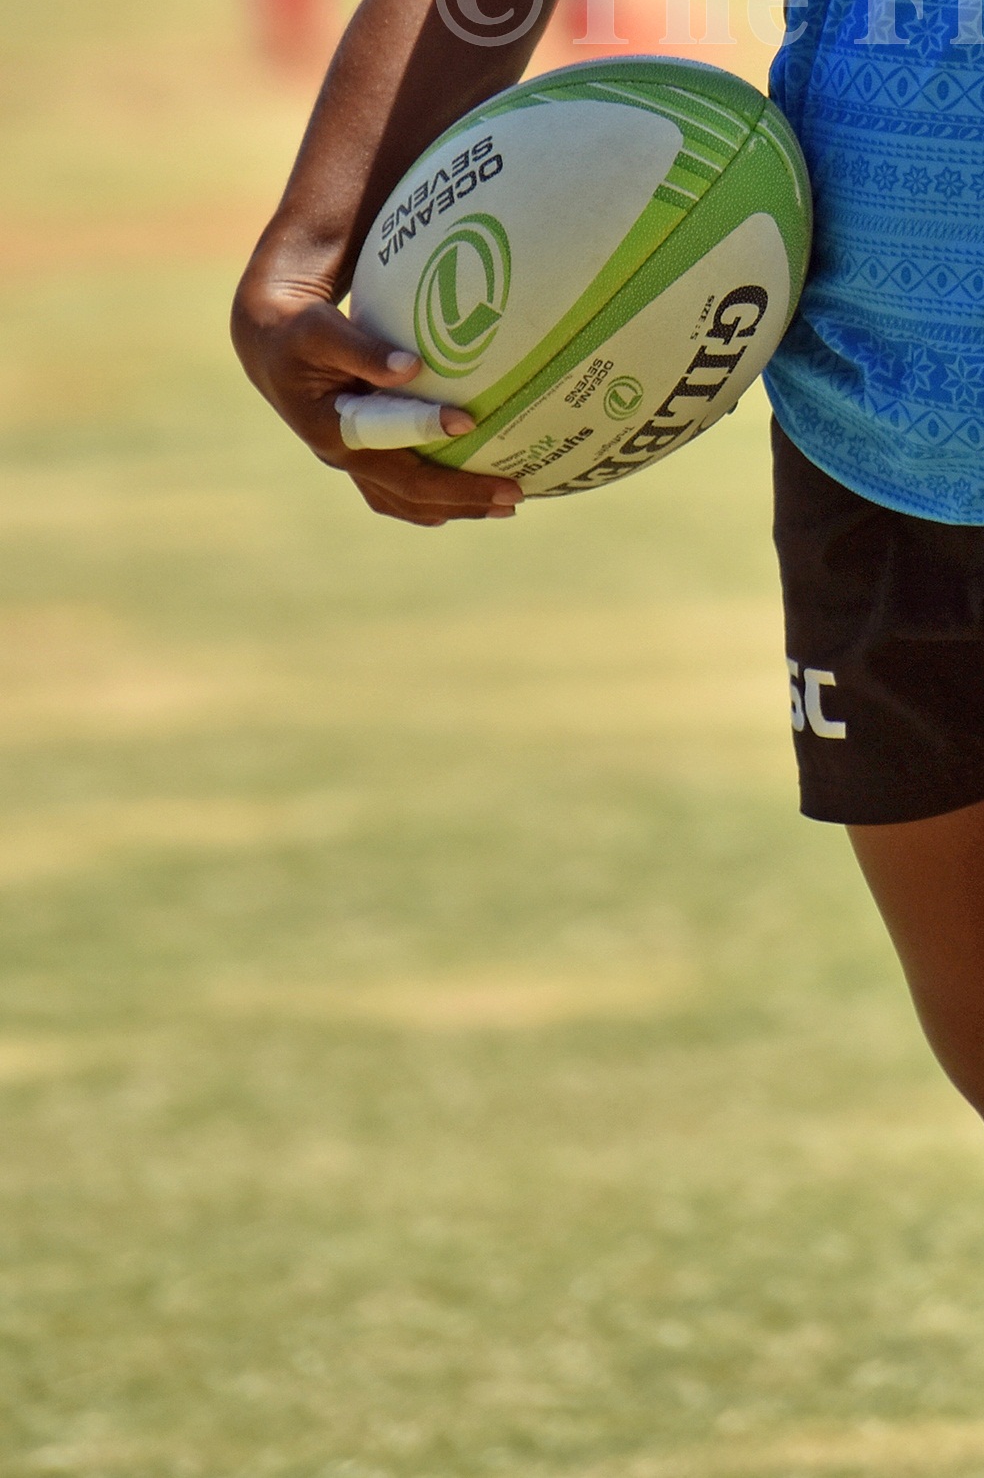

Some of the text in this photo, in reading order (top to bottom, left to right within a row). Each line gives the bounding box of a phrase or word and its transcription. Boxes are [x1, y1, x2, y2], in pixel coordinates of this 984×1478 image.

[378, 154, 503, 266] OCEANIA
[382, 135, 493, 240] SEVENS
[564, 358, 603, 404] SEVENS
[571, 360, 614, 409] OCEANIA
